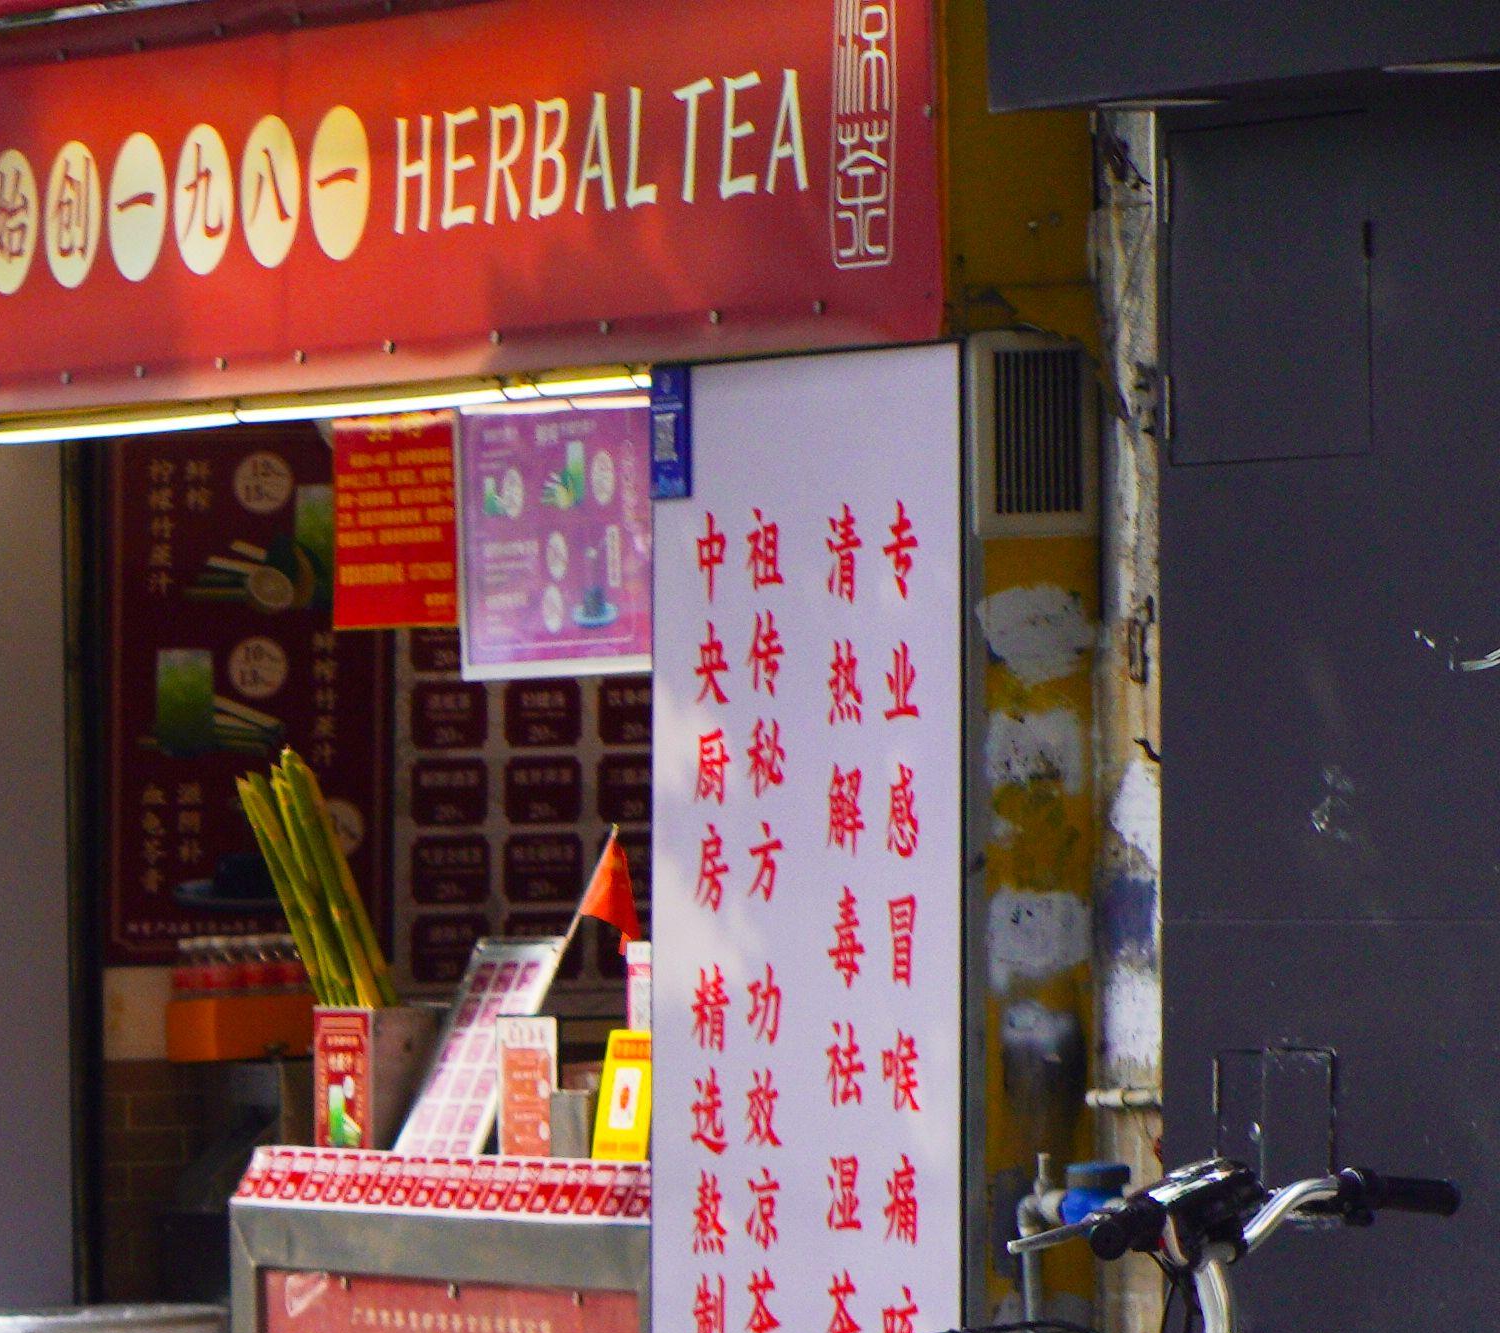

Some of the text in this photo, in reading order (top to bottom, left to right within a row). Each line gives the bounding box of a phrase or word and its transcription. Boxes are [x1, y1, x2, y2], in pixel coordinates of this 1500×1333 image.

[393, 68, 810, 235] HERBAL TEA
[694, 511, 731, 913] 中央厨房
[746, 507, 785, 902] 祖传秘方
